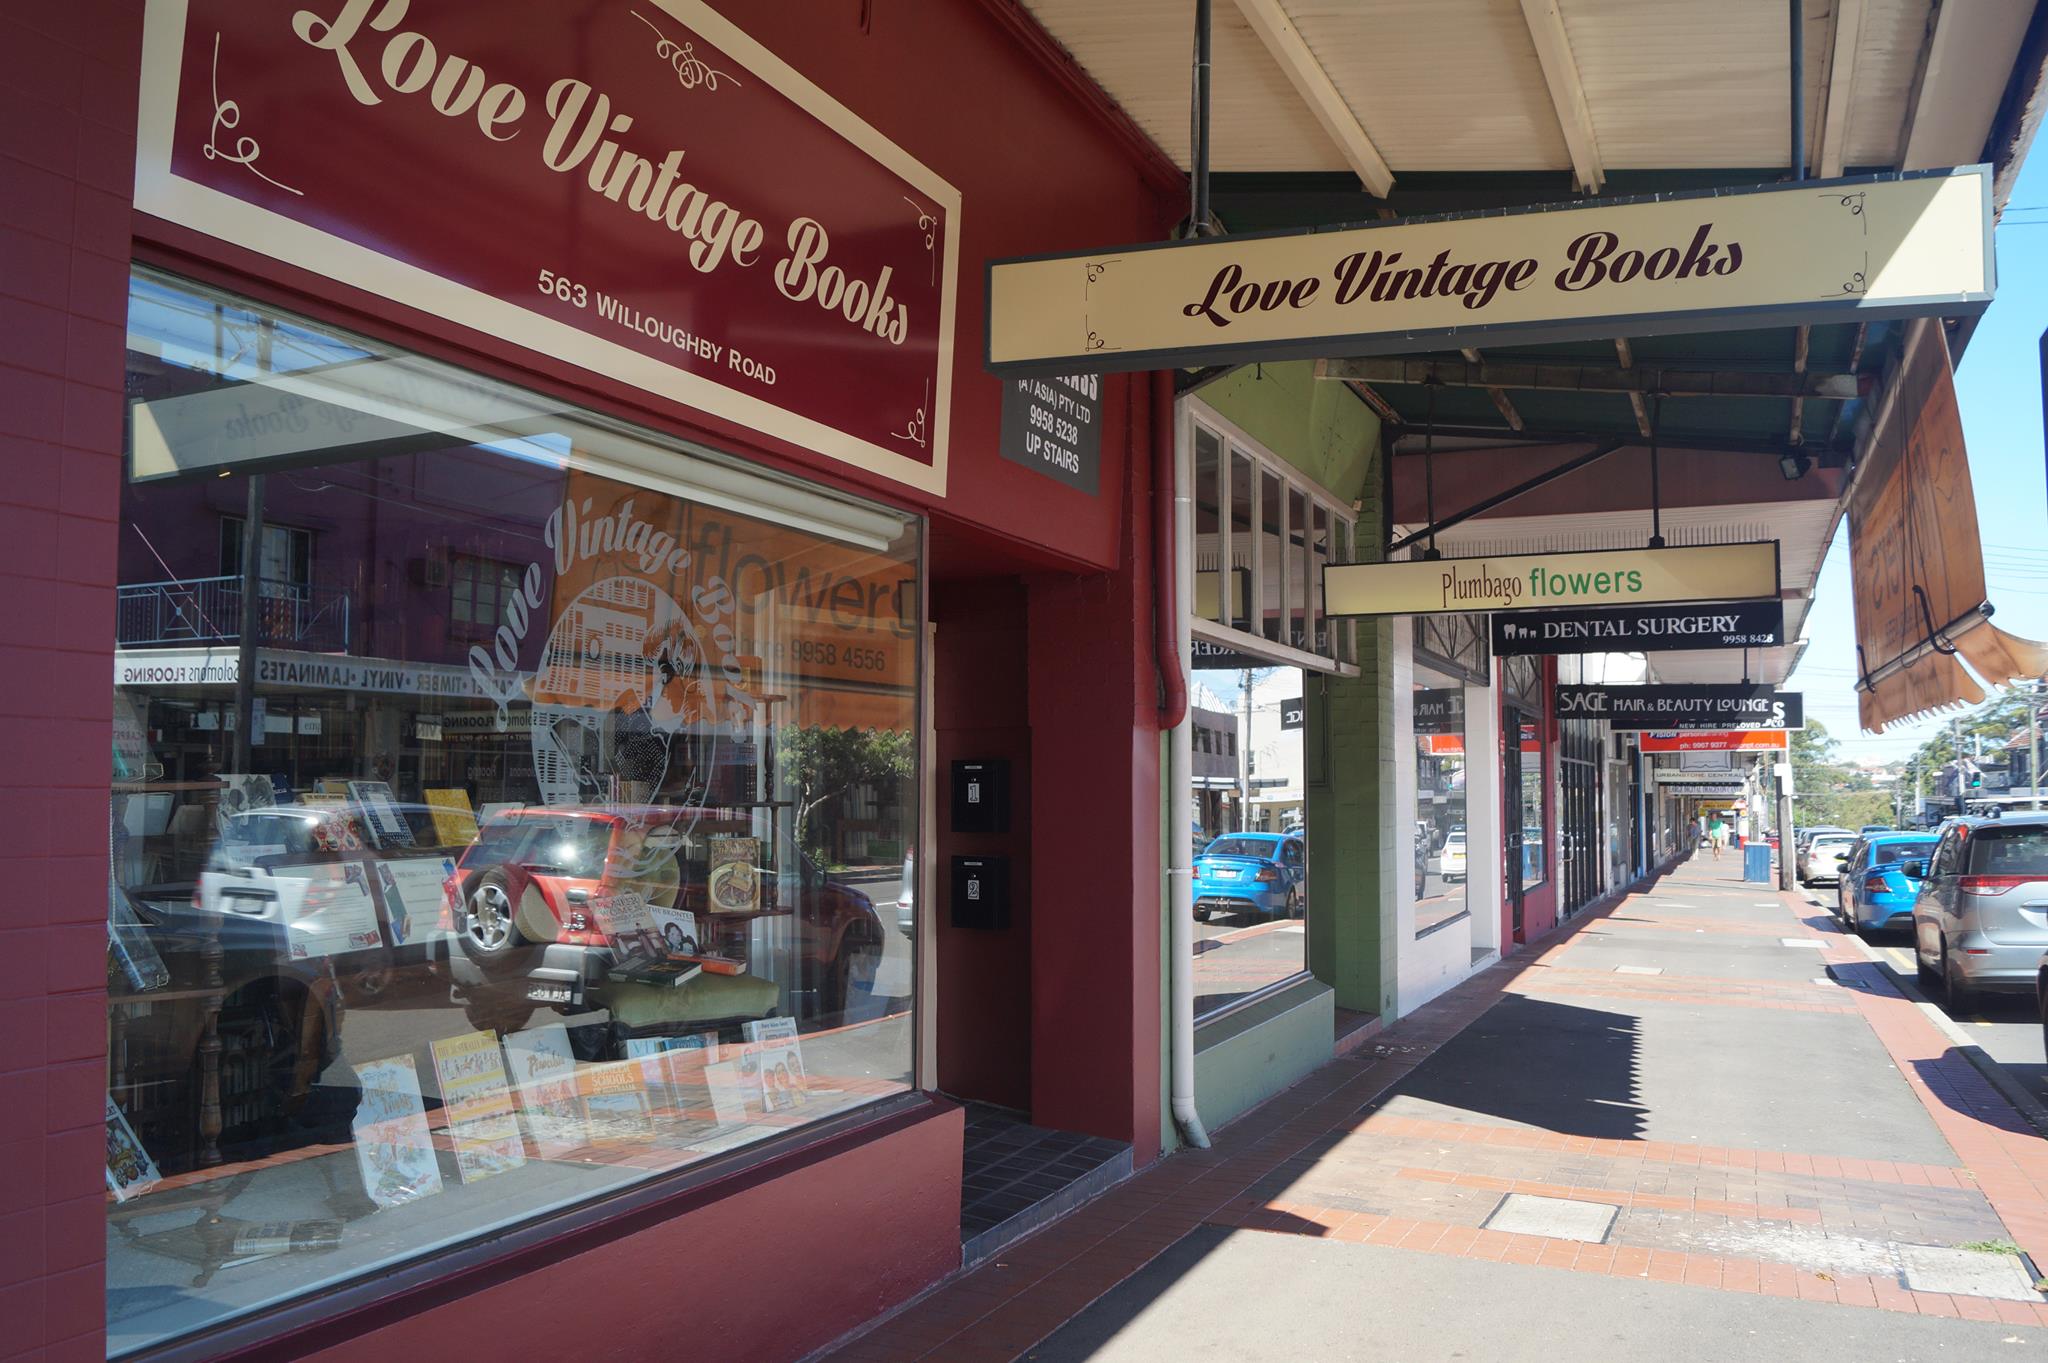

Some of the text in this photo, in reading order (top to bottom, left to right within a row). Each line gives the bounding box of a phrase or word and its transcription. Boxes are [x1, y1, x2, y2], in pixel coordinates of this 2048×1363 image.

[292, 0, 908, 345] Love Vintage Books
[1182, 223, 1743, 327] Love Vintage Books
[537, 268, 776, 385] 563 WILLOUGHBY ROAD
[1058, 393, 1076, 416] PTY
[1076, 403, 1091, 424] LTD
[1030, 404, 1078, 445] 9958 5238
[1026, 431, 1079, 474] UP STAIRS
[1529, 568, 1642, 597] flowers
[469, 562, 545, 733] Love
[545, 496, 691, 576] Vintage
[1543, 614, 1740, 640] DENTAL SURGERY
[790, 638, 836, 665] 9958
[841, 646, 885, 672] 4556
[1723, 634, 1747, 645] 9958
[1560, 692, 1608, 712] SAGE
[1613, 698, 1645, 712] HAIR
[1647, 702, 1655, 712] &
[1657, 698, 1711, 712] BEAUTY
[1679, 720, 1761, 729] NEW HIRE PRELOVED
[969, 784, 978, 802] 1
[968, 881, 979, 899] 2
